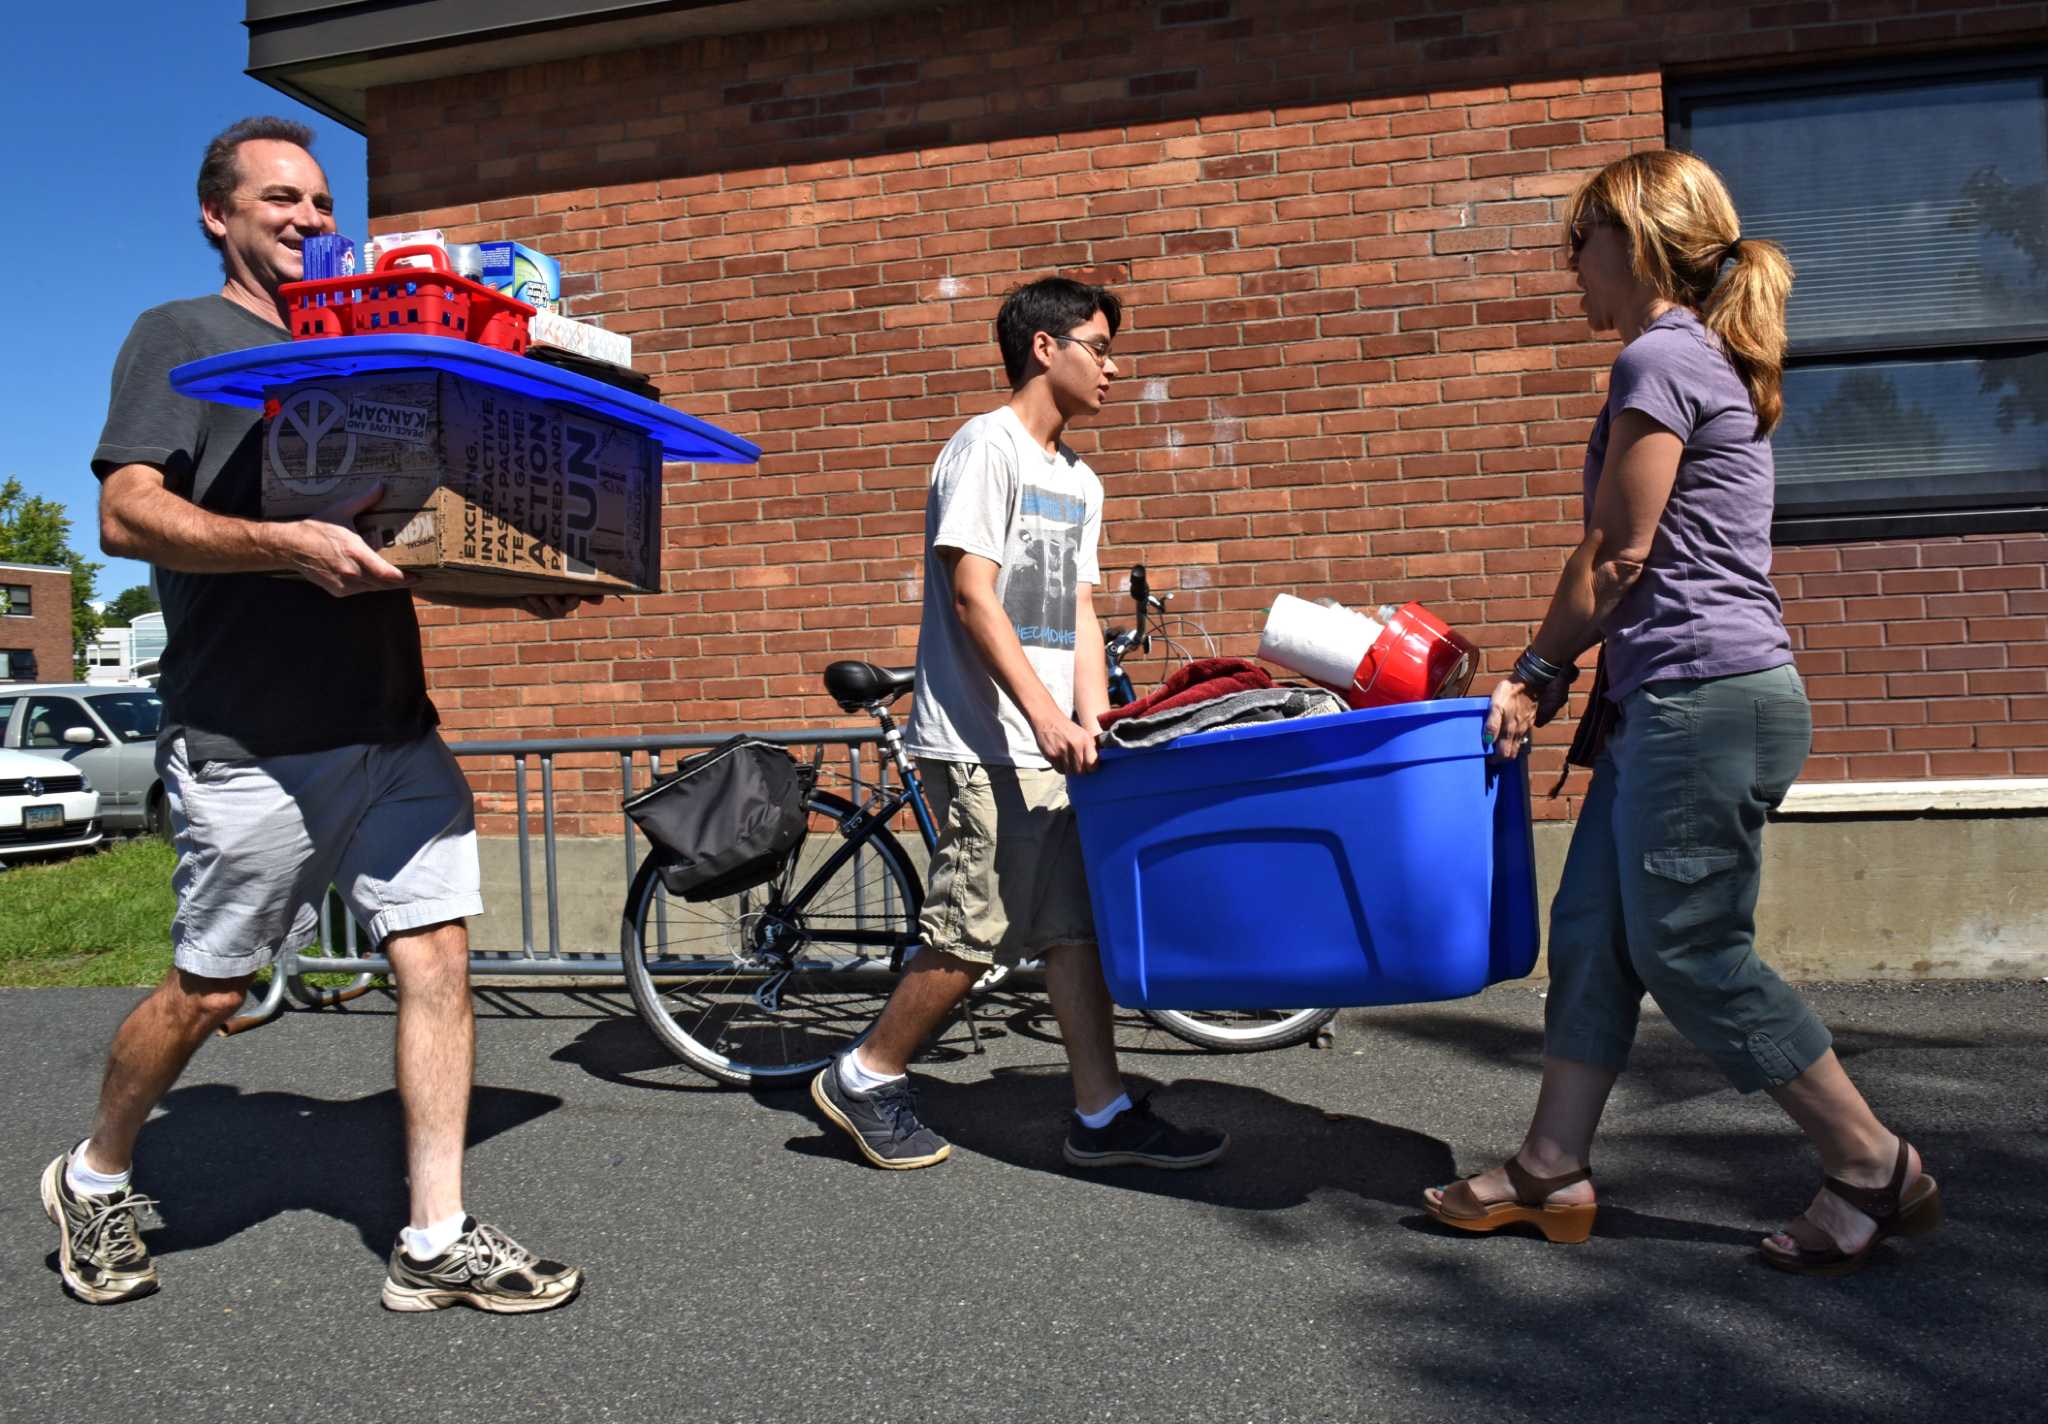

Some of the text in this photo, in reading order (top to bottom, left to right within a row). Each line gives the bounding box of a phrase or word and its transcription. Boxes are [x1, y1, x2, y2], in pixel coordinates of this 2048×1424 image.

[349, 404, 426, 428] KANJAM
[513, 410, 526, 564] TEAM GAME!
[464, 440, 479, 558] EXCITING,
[529, 412, 548, 569] ACTION
[551, 425, 563, 570] PACKED AND
[567, 425, 598, 575] FUN
